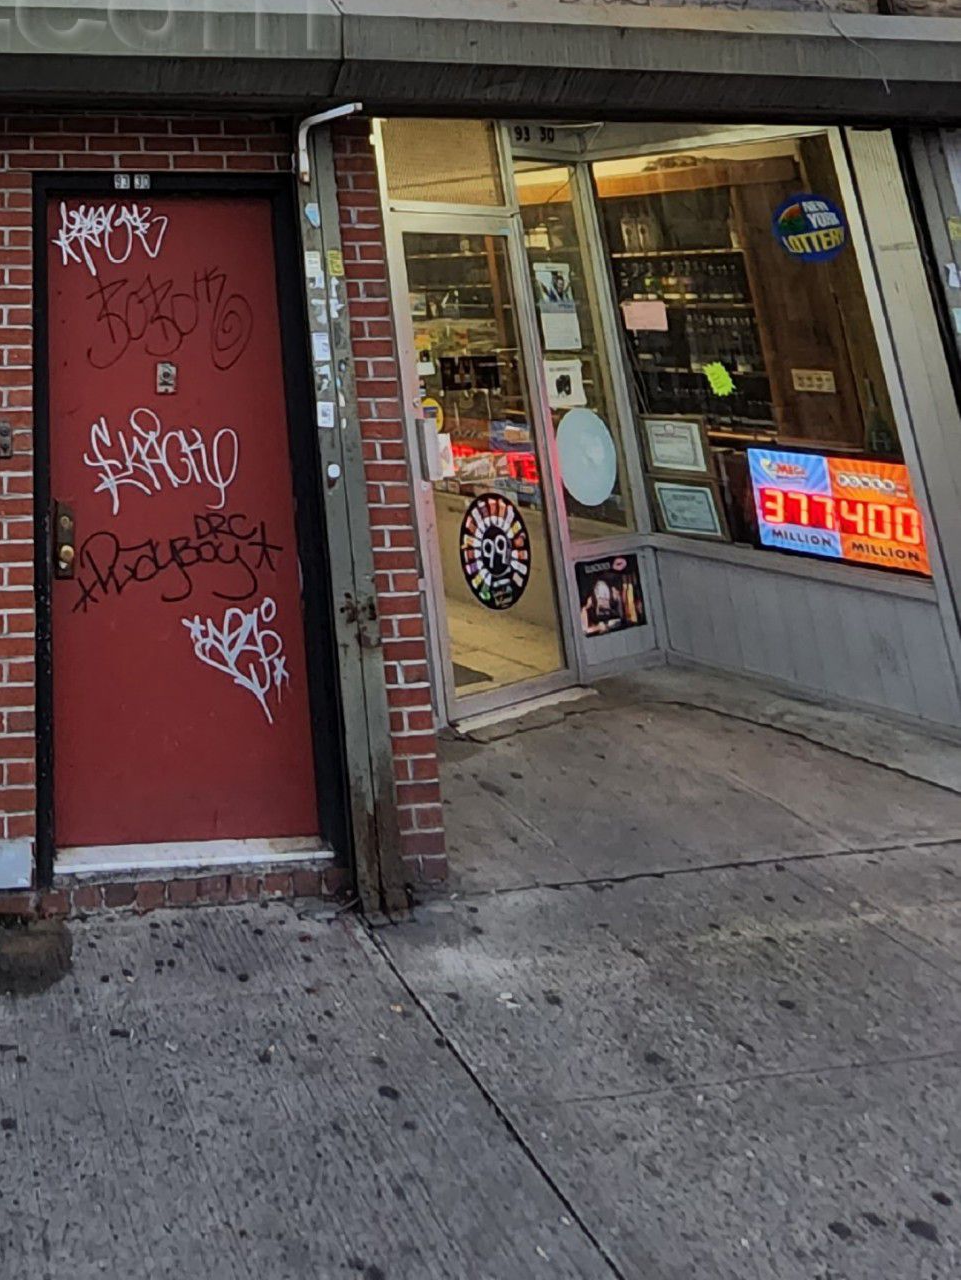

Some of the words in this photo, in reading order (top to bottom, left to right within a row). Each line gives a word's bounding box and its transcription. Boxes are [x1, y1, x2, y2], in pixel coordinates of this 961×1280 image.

[802, 201, 829, 214] NEW
[806, 211, 841, 229] YORK
[782, 226, 845, 253] LOTTERY
[764, 489, 834, 530] 377
[839, 500, 921, 545] 400
[772, 528, 833, 547] MILLION
[851, 541, 921, 562] MILLION
